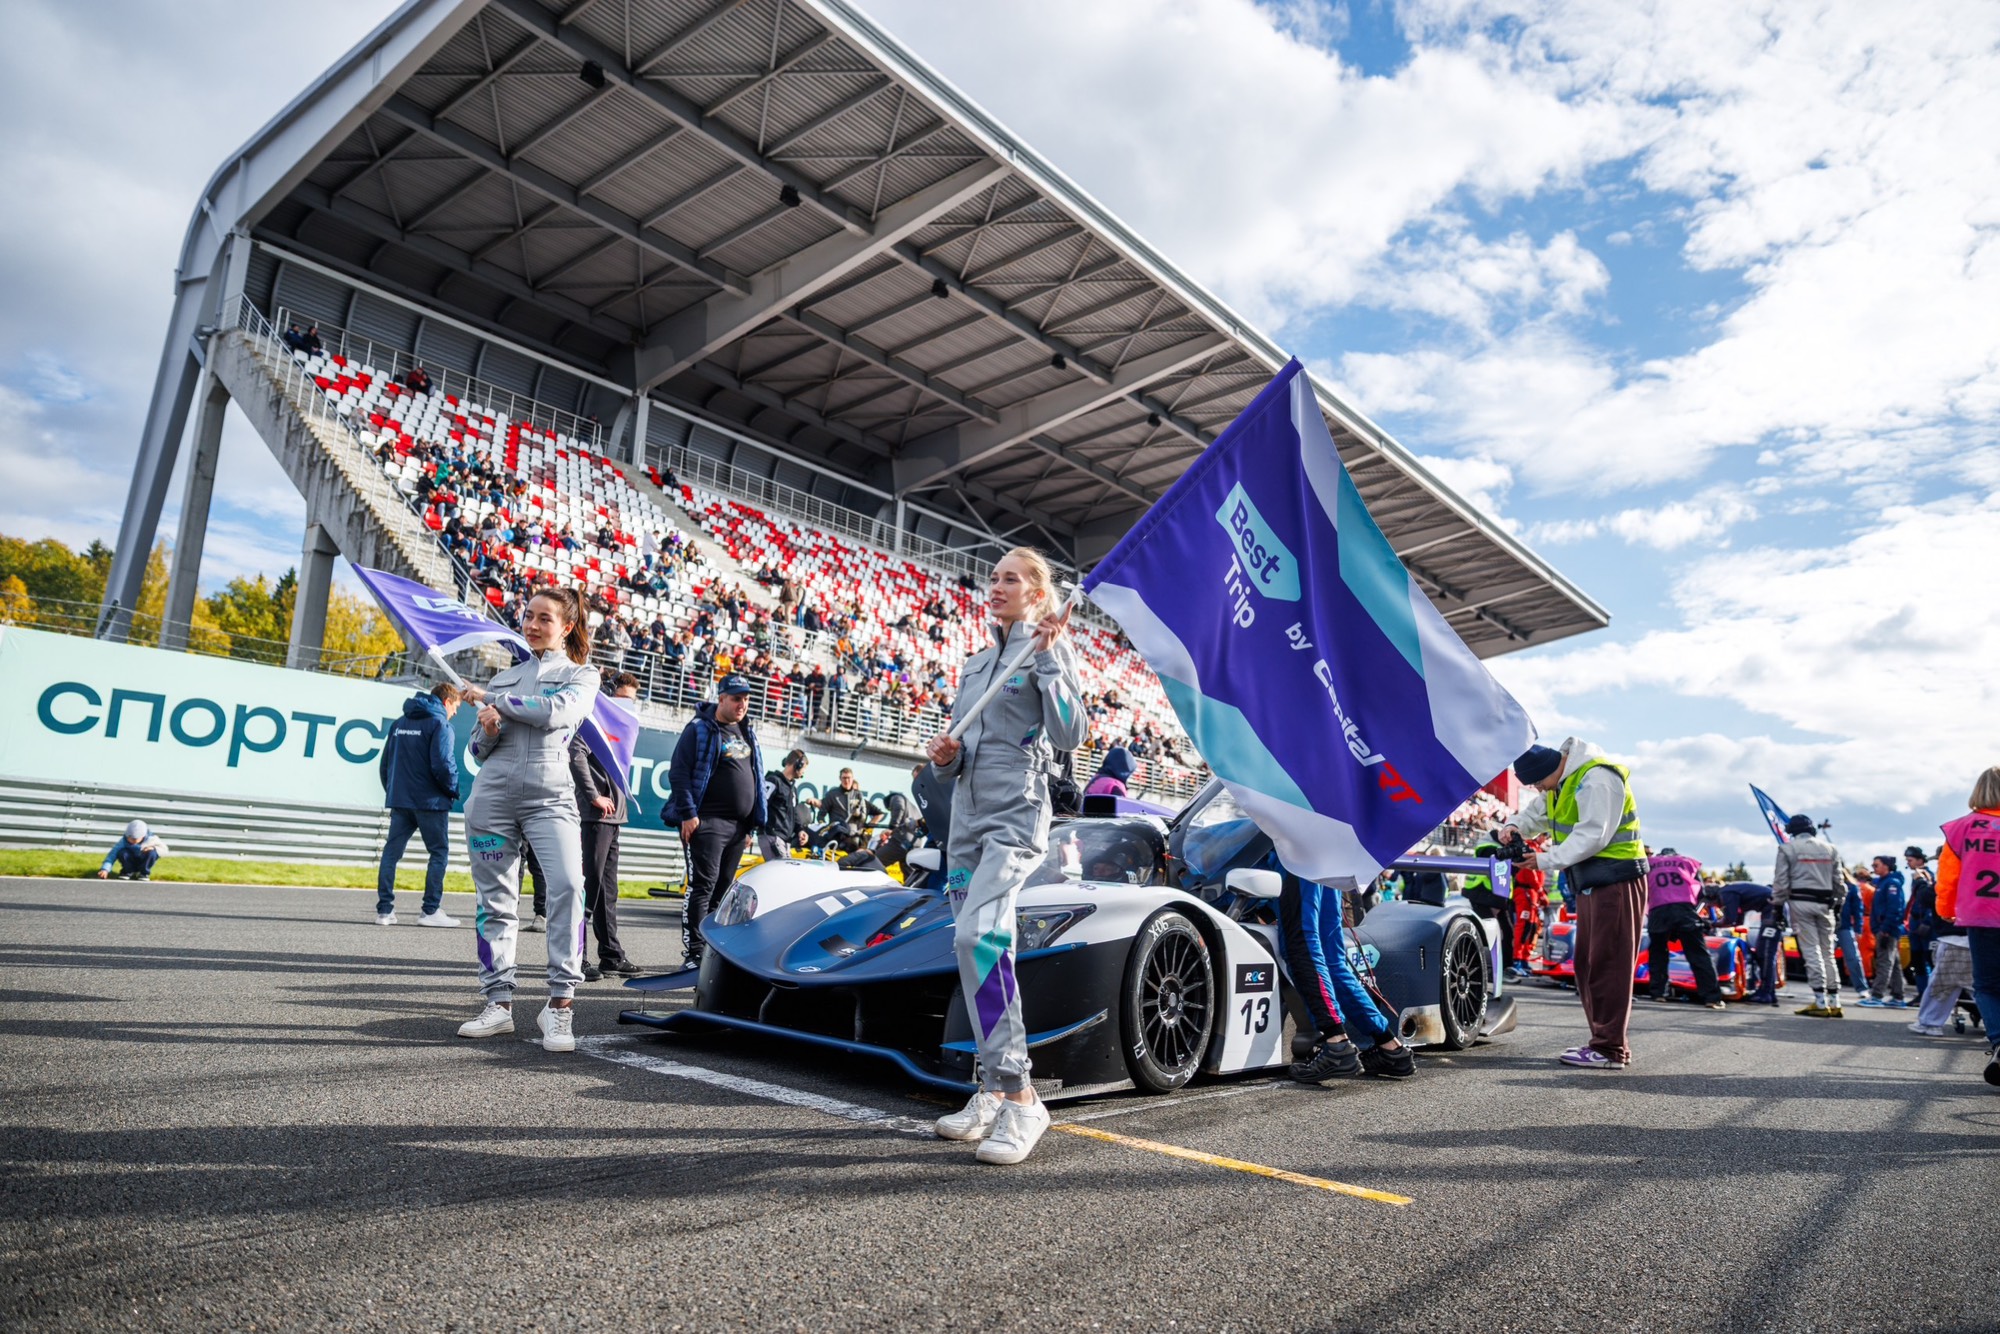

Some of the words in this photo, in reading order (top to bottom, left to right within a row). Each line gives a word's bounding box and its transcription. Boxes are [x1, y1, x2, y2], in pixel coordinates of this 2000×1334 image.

[1230, 499, 1281, 585] Best
[1224, 552, 1256, 629] Trip
[1284, 621, 1314, 651] by
[472, 837, 498, 849] Best
[1964, 838, 2000, 853] ME
[480, 850, 504, 862] Trip
[949, 871, 967, 885] est
[1655, 872, 1685, 888] 08
[950, 888, 968, 901] Tri
[682, 885, 694, 924] ADIDAS
[1240, 996, 1271, 1036] 13
